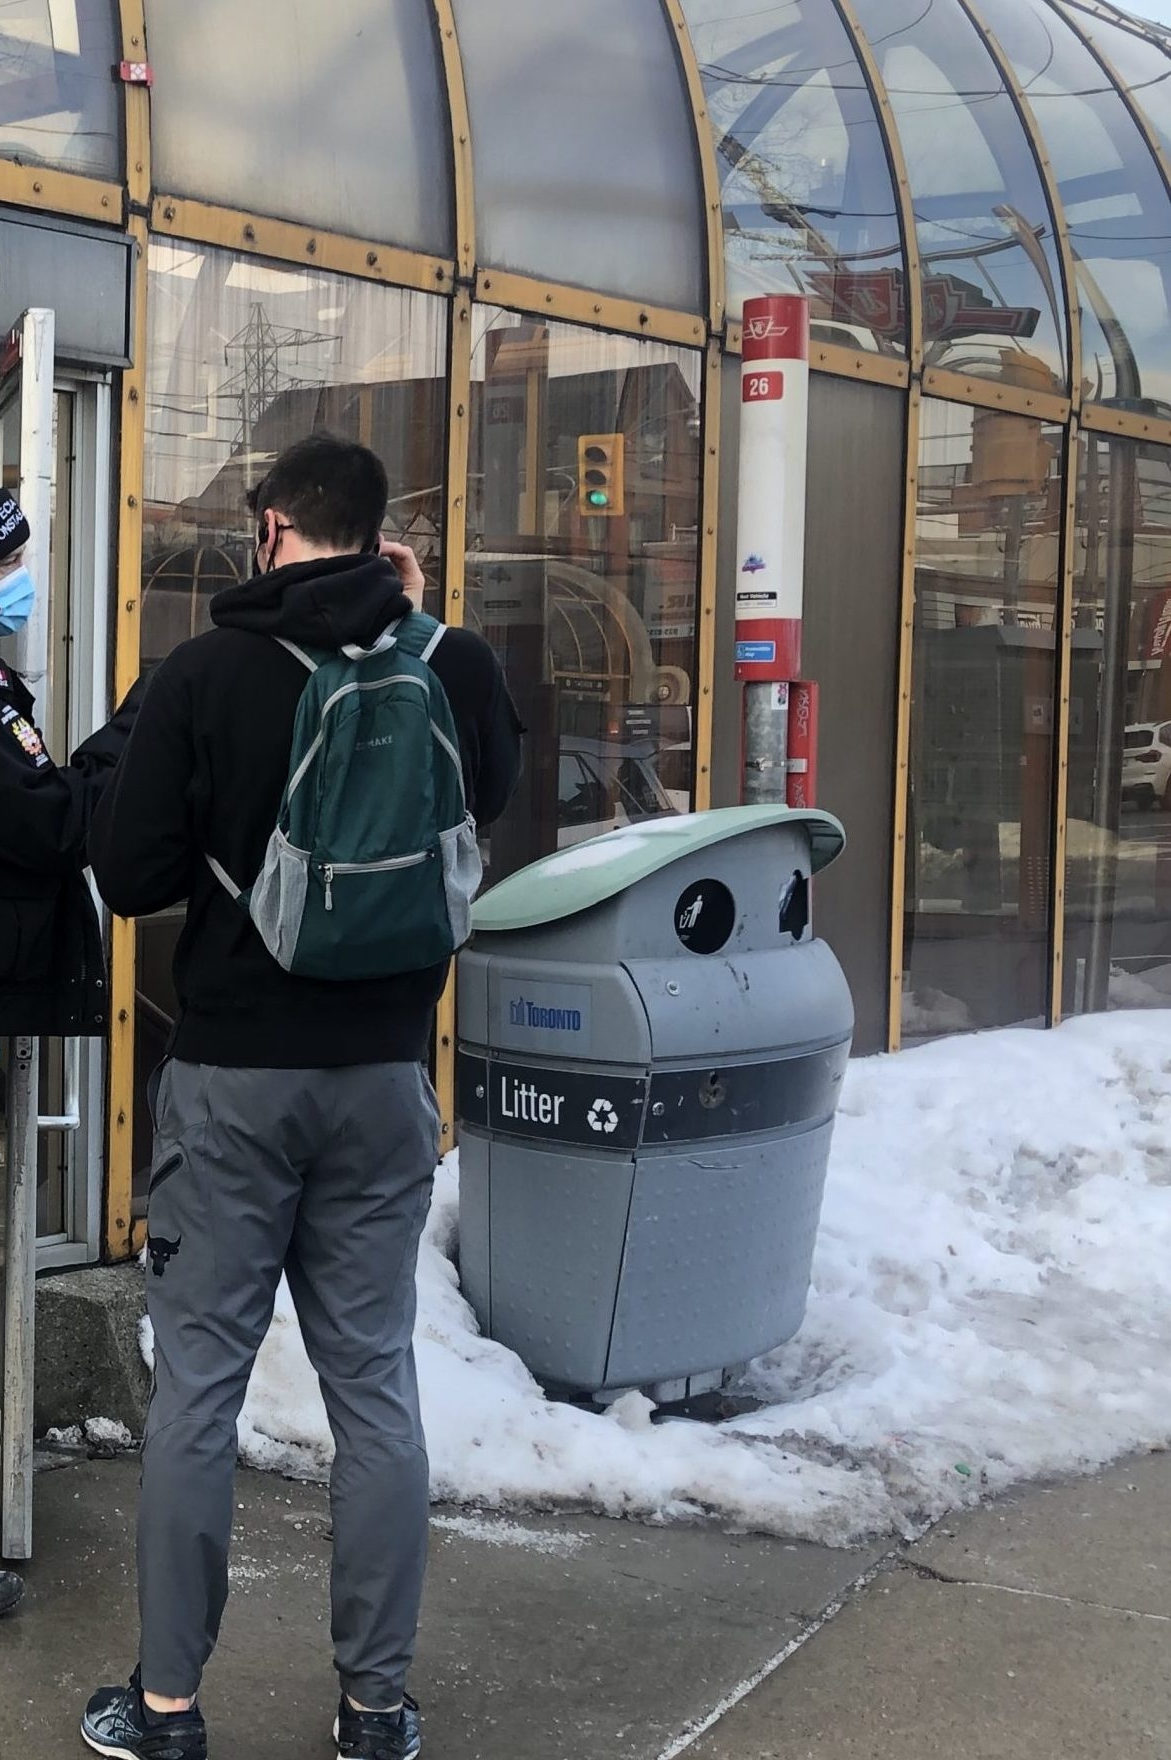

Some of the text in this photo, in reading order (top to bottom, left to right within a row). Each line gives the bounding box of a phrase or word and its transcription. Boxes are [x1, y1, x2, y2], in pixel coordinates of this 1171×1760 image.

[749, 377, 769, 397] 26
[526, 1001, 581, 1031] TORONTO
[501, 1076, 565, 1125] Litter
